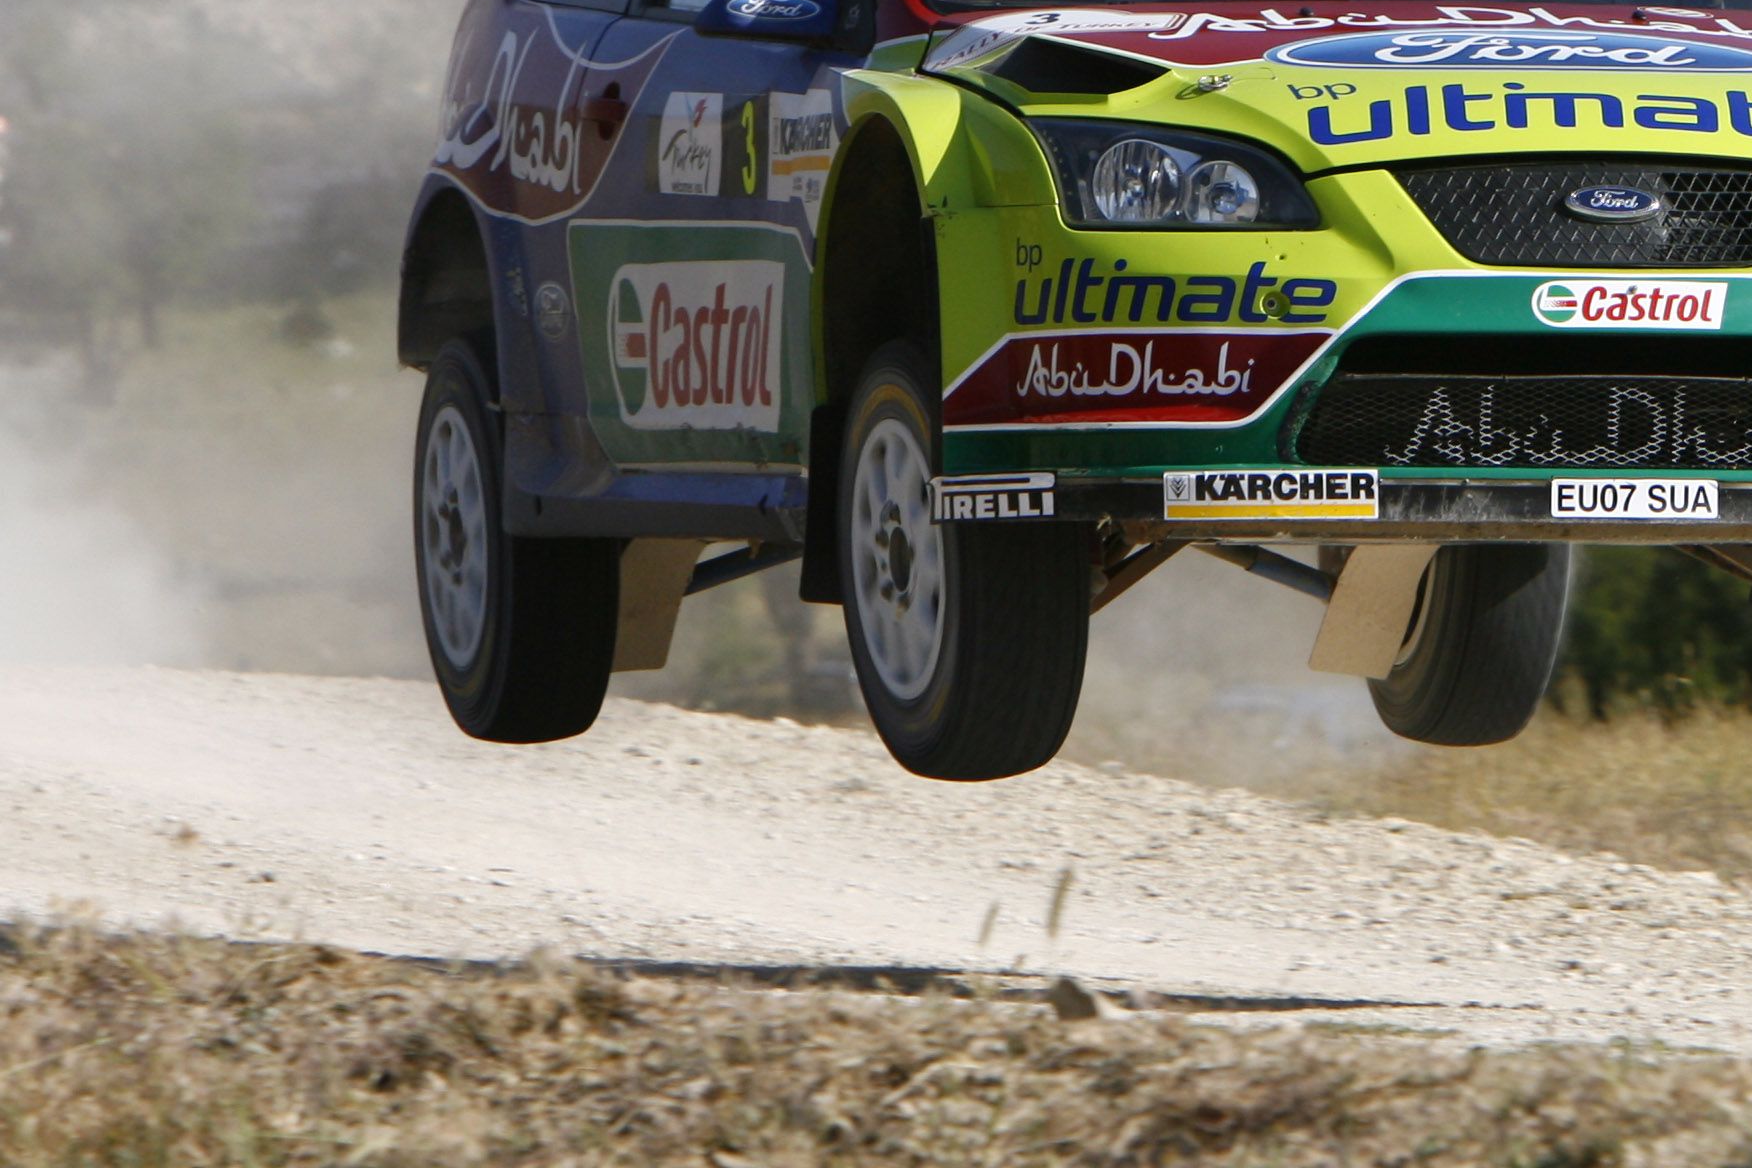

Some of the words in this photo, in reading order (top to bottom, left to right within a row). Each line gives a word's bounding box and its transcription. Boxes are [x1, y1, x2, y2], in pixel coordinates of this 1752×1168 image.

[1025, 13, 1061, 25] 3
[1059, 21, 1157, 31] TURKEY
[1374, 30, 1696, 67] Ford
[1287, 80, 1357, 100] bp
[741, 100, 756, 195] 3
[1590, 189, 1638, 209] Ford
[1016, 238, 1042, 268] bp
[1014, 258, 1337, 325] ultimate
[1582, 285, 1712, 322] Castrol
[649, 281, 772, 409] Castrol
[930, 472, 1055, 520] PIRELLI
[1556, 485, 1637, 513] EU07
[1647, 485, 1712, 513] SUA
